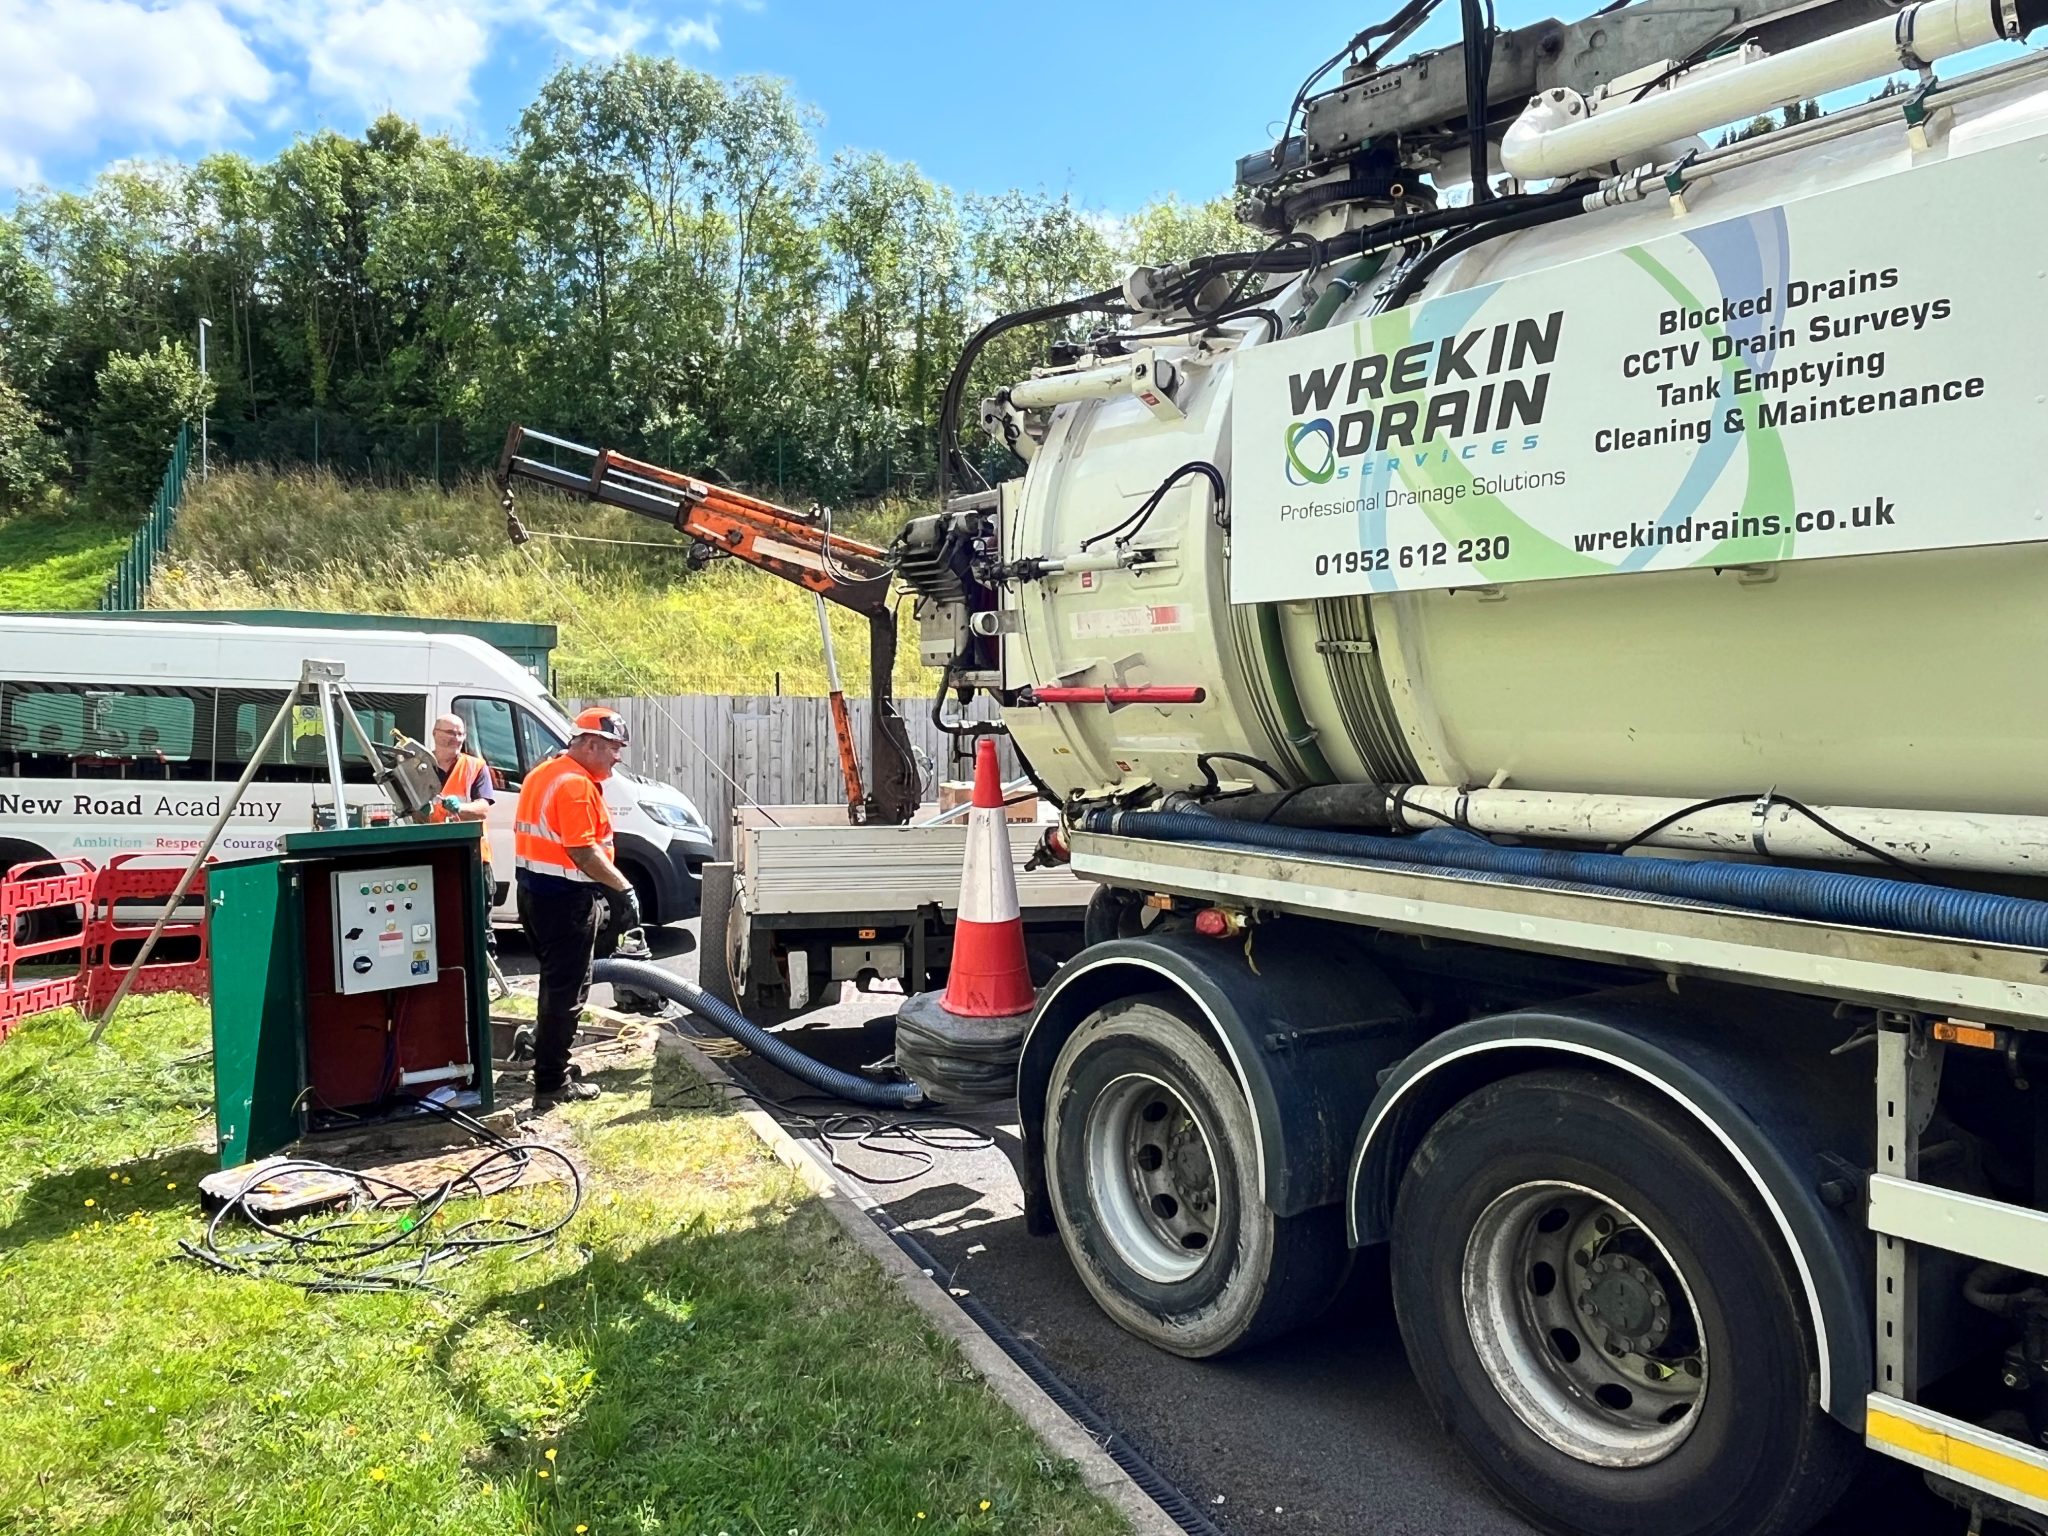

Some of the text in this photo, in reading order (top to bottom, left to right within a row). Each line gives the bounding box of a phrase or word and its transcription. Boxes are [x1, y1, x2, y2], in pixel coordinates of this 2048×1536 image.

[1659, 267, 1899, 335] Blocked Drains
[1288, 311, 1564, 416] WREKIN
[1623, 298, 1951, 378] CCTV Drain Surveys
[1657, 351, 1885, 408] Tank Emptying
[1336, 372, 1551, 458] DRAIN
[1595, 377, 1985, 453] Cleaning & Maintenance
[1336, 435, 1539, 480] SERVICES
[1280, 470, 1566, 521] Professional Drainage Solutions
[1574, 497, 1896, 552] wrekindrains.co.uk
[1315, 536, 1510, 576] 01952 612 230
[0, 794, 63, 814] New
[74, 795, 143, 815] Road
[73, 837, 143, 849] Ambition
[156, 838, 207, 850] Respec
